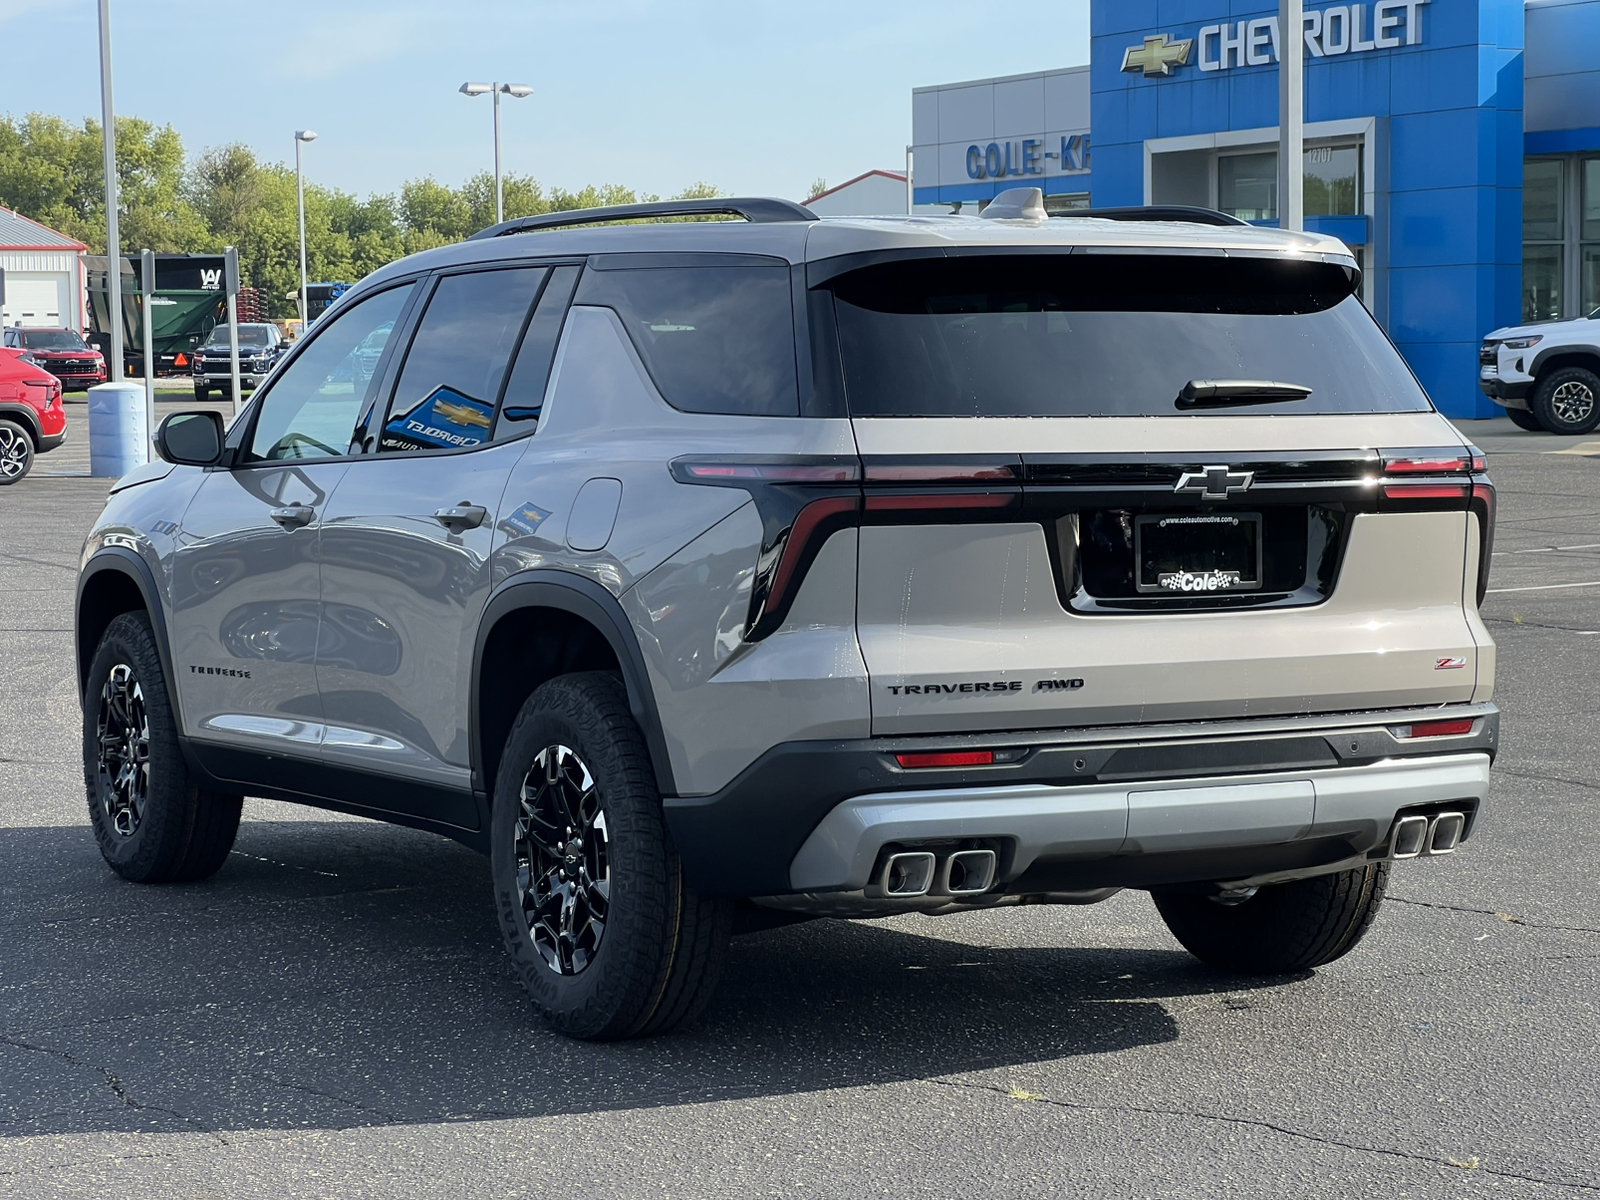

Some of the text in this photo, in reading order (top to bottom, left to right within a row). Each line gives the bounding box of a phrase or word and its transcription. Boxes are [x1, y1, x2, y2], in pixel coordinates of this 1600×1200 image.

[1309, 147, 1332, 163] 12707
[1165, 516, 1233, 524] www.coleautomotive.com
[1181, 573, 1218, 591] Cole
[190, 665, 252, 679] TRAVERSE
[888, 678, 1085, 695] TRAVERSE AWD
